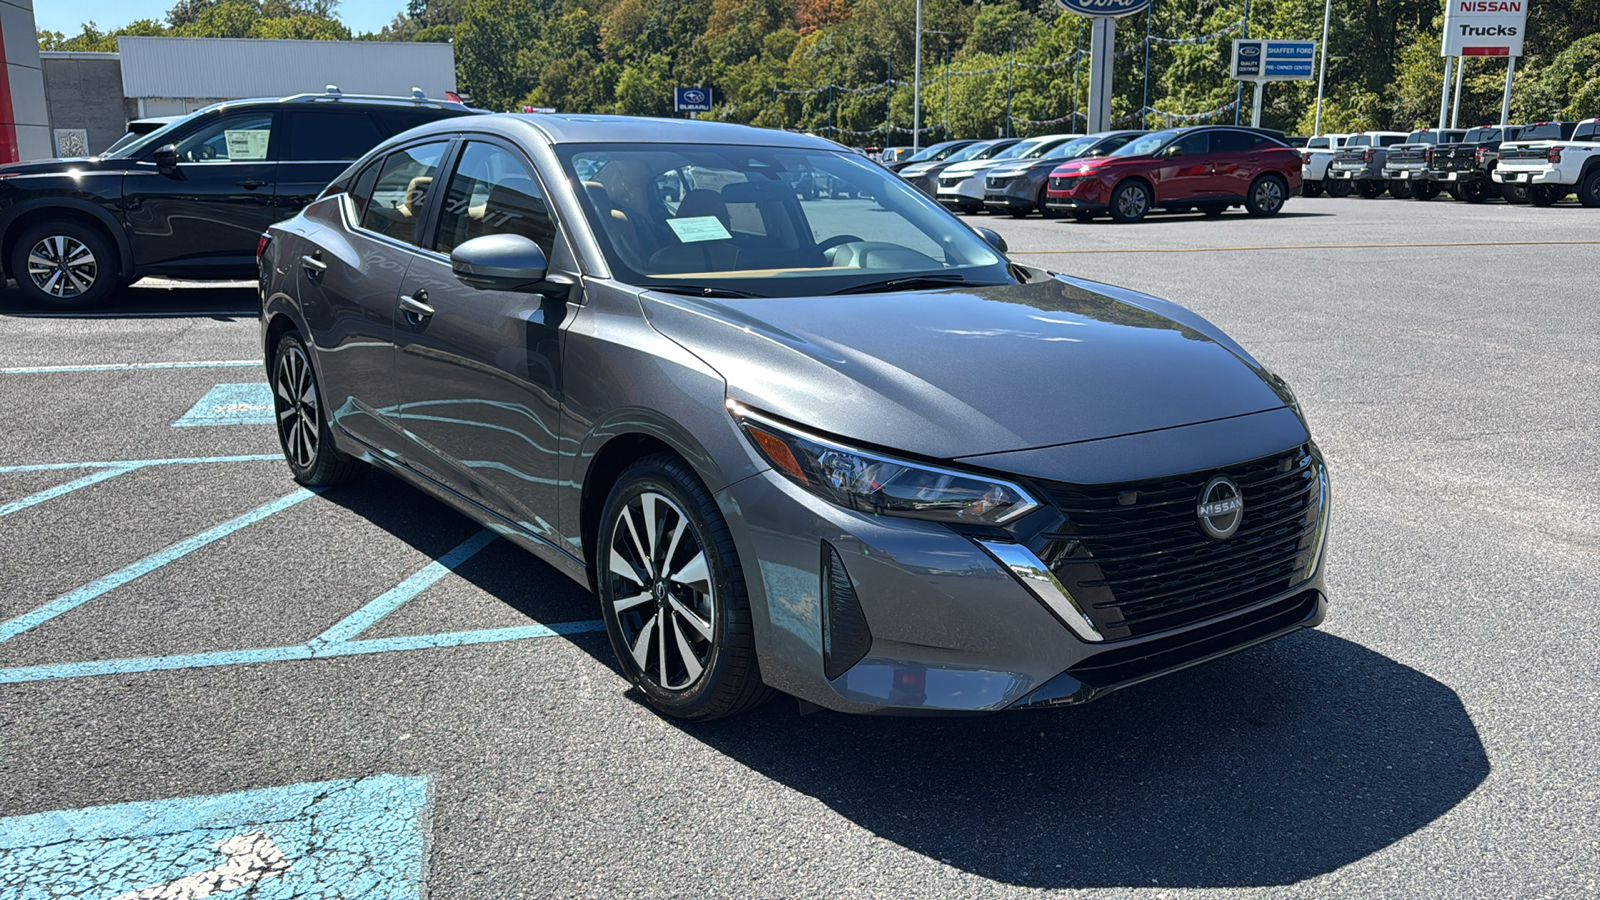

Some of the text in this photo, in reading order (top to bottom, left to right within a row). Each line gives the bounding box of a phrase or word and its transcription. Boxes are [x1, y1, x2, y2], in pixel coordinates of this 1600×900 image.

[1460, 2, 1521, 12] NISSAN
[1459, 24, 1517, 36] Trucks
[1200, 499, 1242, 515] NISSAN
